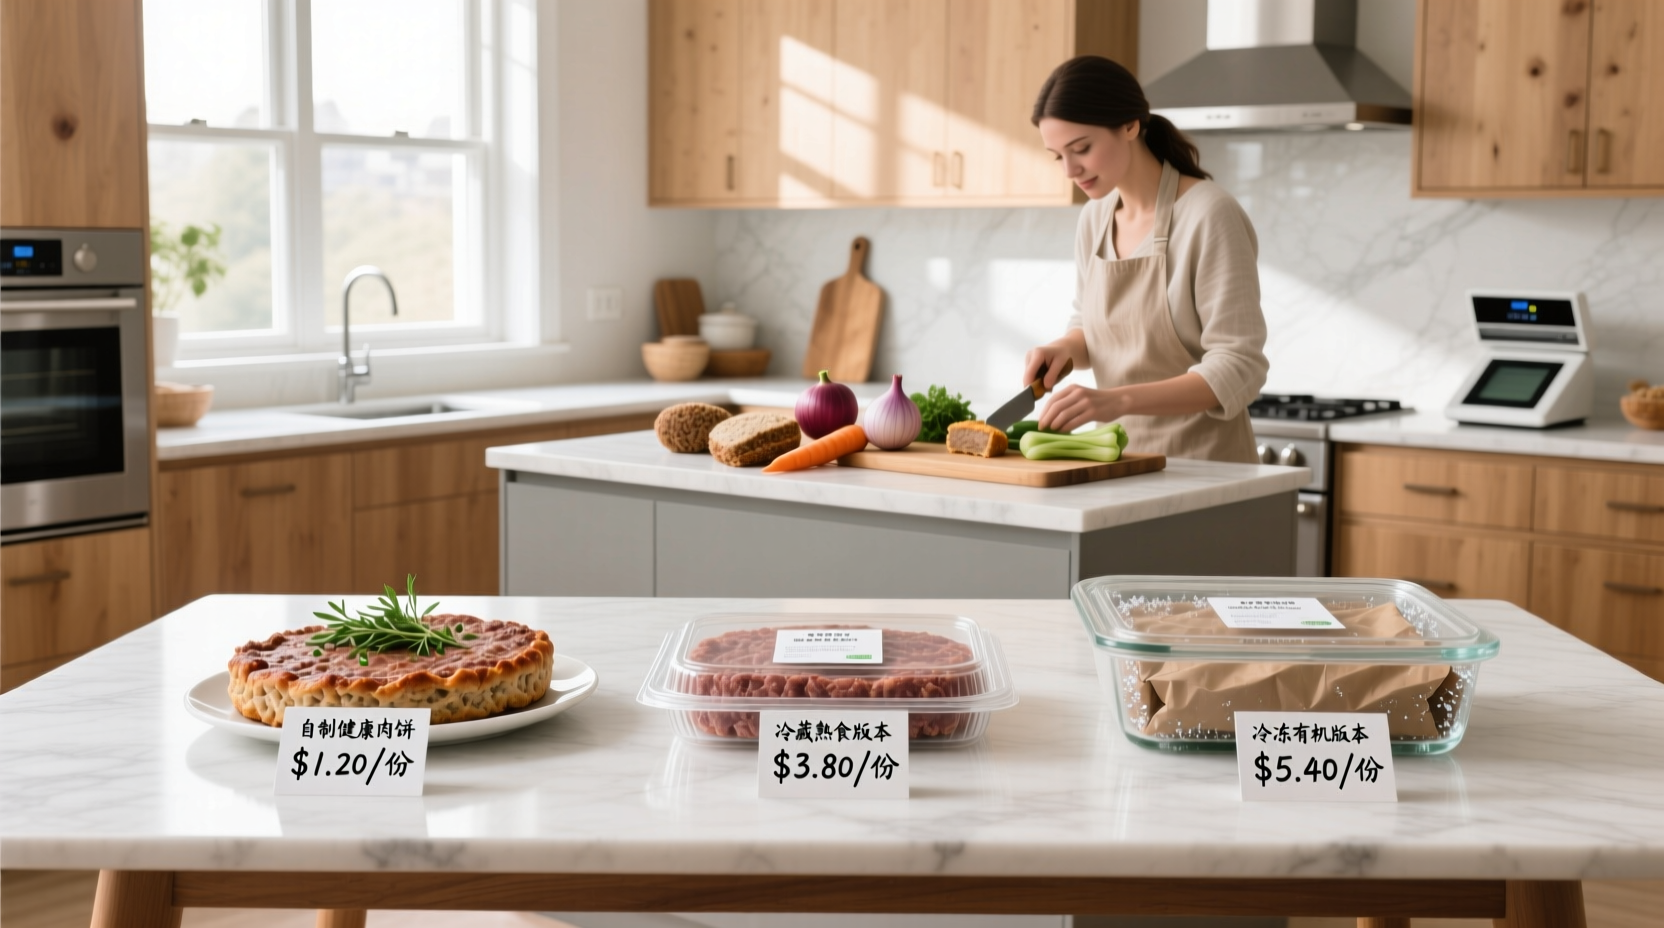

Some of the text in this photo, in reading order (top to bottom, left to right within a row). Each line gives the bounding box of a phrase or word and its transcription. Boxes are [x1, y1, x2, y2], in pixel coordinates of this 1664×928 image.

[302, 718, 416, 740] 自制健康肉饼
[1252, 722, 1369, 744] 冷冻有机版本
[291, 746, 414, 785] $1.20/份
[773, 748, 900, 788] $3.80/份
[1254, 750, 1384, 790] $5.40/份
